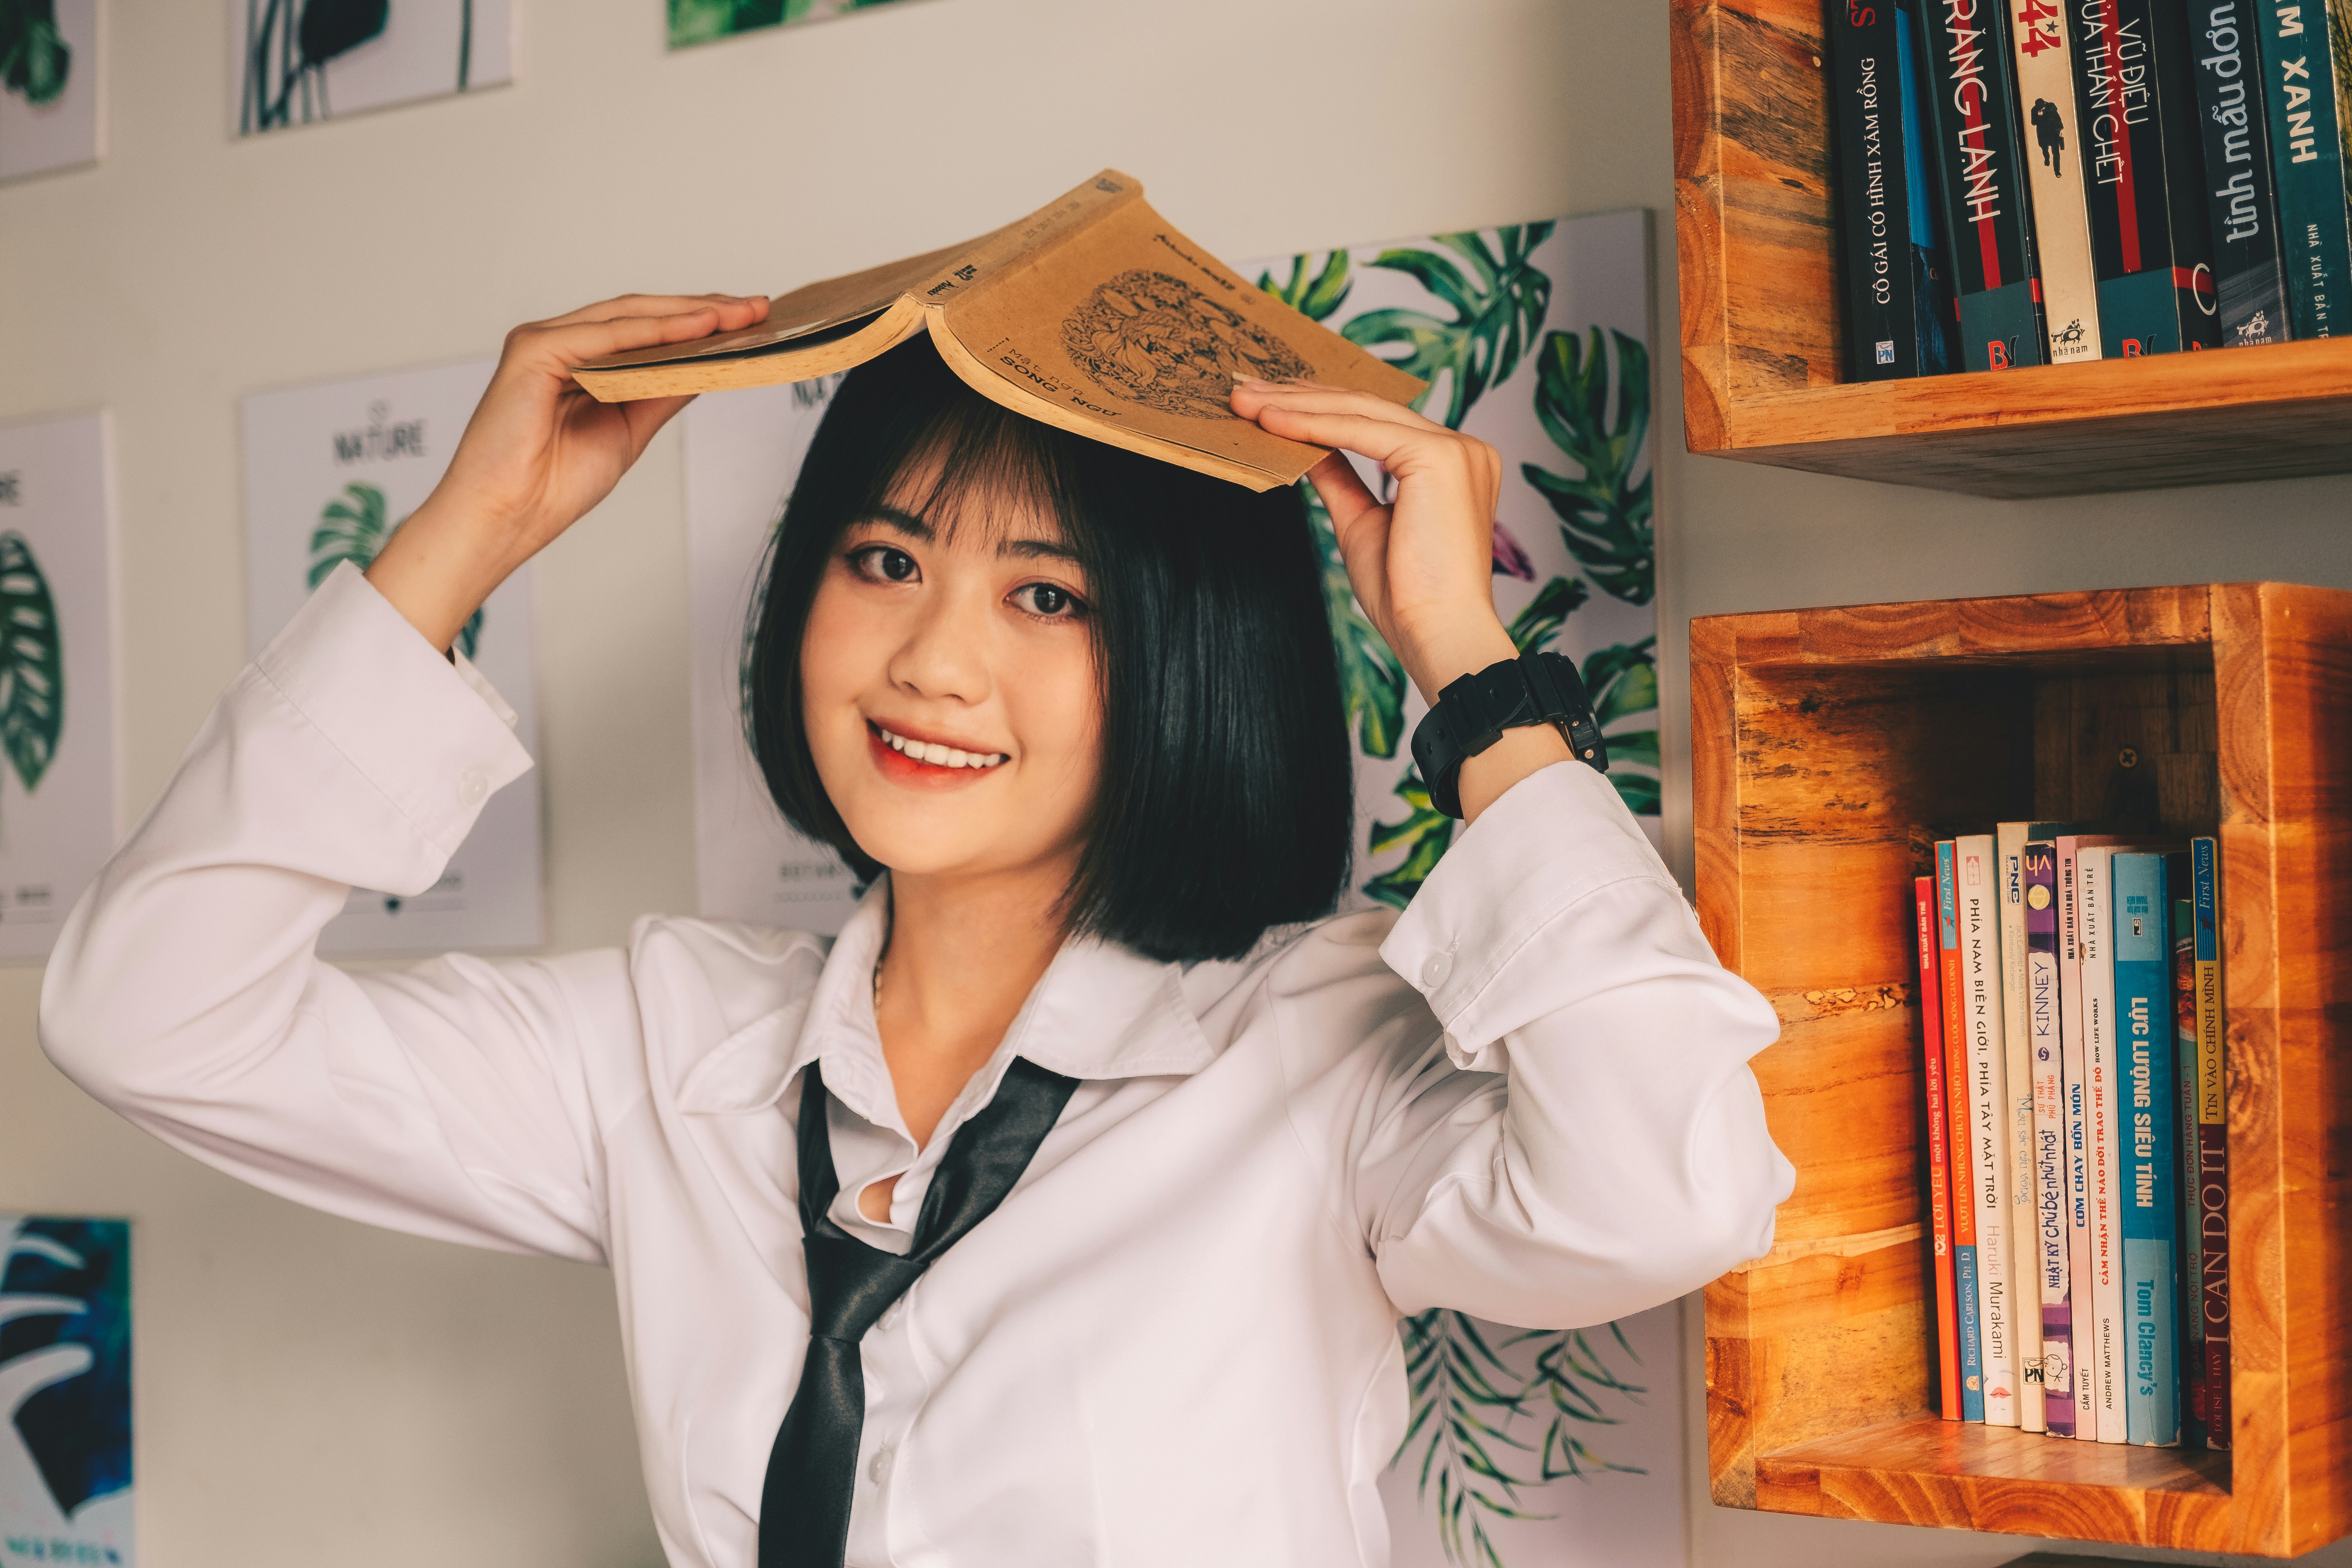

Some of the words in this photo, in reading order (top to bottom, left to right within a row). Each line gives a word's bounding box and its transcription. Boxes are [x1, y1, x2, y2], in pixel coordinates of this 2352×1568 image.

[2082, 0, 2111, 41] ỦA
[2115, 18, 2147, 60] VŨ
[2201, 1, 2242, 78] đơn
[1856, 57, 1878, 110] RỒNG
[2085, 42, 2117, 109] THẦN
[2119, 65, 2150, 124] ĐIỆU
[2281, 56, 2318, 164] XANH
[1864, 113, 1881, 157] XĂM
[2211, 79, 2251, 163] mẫu
[2093, 114, 2125, 184] CHẾT
[1866, 161, 1884, 207] HÌNH
[1958, 124, 2000, 222] LẠNH
[1868, 211, 1886, 237] CÓ
[2307, 224, 2323, 248] NHÀ
[1870, 240, 1889, 274] GÁI
[2310, 255, 2329, 287] XUẤT
[1872, 278, 1890, 304] CÔ
[2315, 294, 2331, 320] BẢN
[2070, 344, 2089, 355] nam
[2255, 336, 2272, 345] nam
[999, 355, 1059, 392] SONG
[1942, 857, 1951, 885] News
[2084, 867, 2093, 885] TRẺ
[2198, 845, 2210, 877] News
[1943, 887, 1952, 911] First
[2086, 890, 2095, 908] BẢN
[2199, 880, 2210, 910] First
[1969, 898, 1983, 934] PHÍA
[2086, 912, 2096, 936] XUẤT
[1972, 938, 1983, 974] NAM
[2017, 940, 2025, 969] Canfield
[1974, 980, 1987, 1015] BIÊN
[2034, 961, 2050, 1036] KINNEY
[2201, 966, 2215, 1005] MÌNH
[2128, 997, 2149, 1035] LỰC
[2203, 1008, 2216, 1054] CHÍNH
[1976, 1020, 1990, 1056] GIỚI,
[1929, 1057, 1939, 1076] yêu
[1978, 1062, 1992, 1097] PHÍA
[2092, 1066, 2102, 1083] ĐÓ
[2130, 1041, 2151, 1108] LƯỢNG
[2204, 1058, 2217, 1089] VÀO
[1931, 1093, 1939, 1109] hai
[2070, 1084, 2081, 1116] MÓN
[2092, 1086, 2103, 1109] THẾ
[2205, 1093, 2218, 1120] TIN
[1932, 1110, 1941, 1141] không
[1980, 1101, 1993, 1132] TÂY
[2096, 1111, 2104, 1144] TRAO
[2070, 1121, 2083, 1150] BỐN
[2134, 1113, 2156, 1158] SIÊU
[1934, 1143, 1942, 1163] một
[1981, 1137, 1996, 1171] MẶT
[2096, 1145, 2105, 1167] ĐỜI
[2074, 1155, 2084, 1193] CHAY
[2096, 1169, 2106, 1194] NÀO
[2135, 1162, 2158, 1207] TÍNH
[1984, 1174, 1999, 1209] TRỜI
[2074, 1197, 2085, 1228] CƠM
[2096, 1197, 2107, 1221] THẾ
[2202, 1184, 2227, 1240] DO
[1986, 1225, 2002, 1276] Haruki
[2098, 1223, 2110, 1257] NHẬN
[2045, 1259, 2063, 1289] NHẬT
[2098, 1260, 2109, 1286] CẢM
[2204, 1248, 2229, 1323] CAN
[2137, 1279, 2154, 1317] Tom
[1989, 1282, 2007, 1359] Murakami
[1966, 1327, 1977, 1366] RICHARD
[2103, 1318, 2112, 1368] MATTHEWS
[2206, 1333, 2229, 1345] I
[2137, 1321, 2158, 1397] Clancy's
[2212, 1351, 2221, 1376] HAY
[2080, 1367, 2090, 1392] TUYẾT
[2104, 1371, 2113, 1410] ANDREW
[2079, 1394, 2090, 1410] CẨM
[2214, 1393, 2223, 1432] LOUISE
